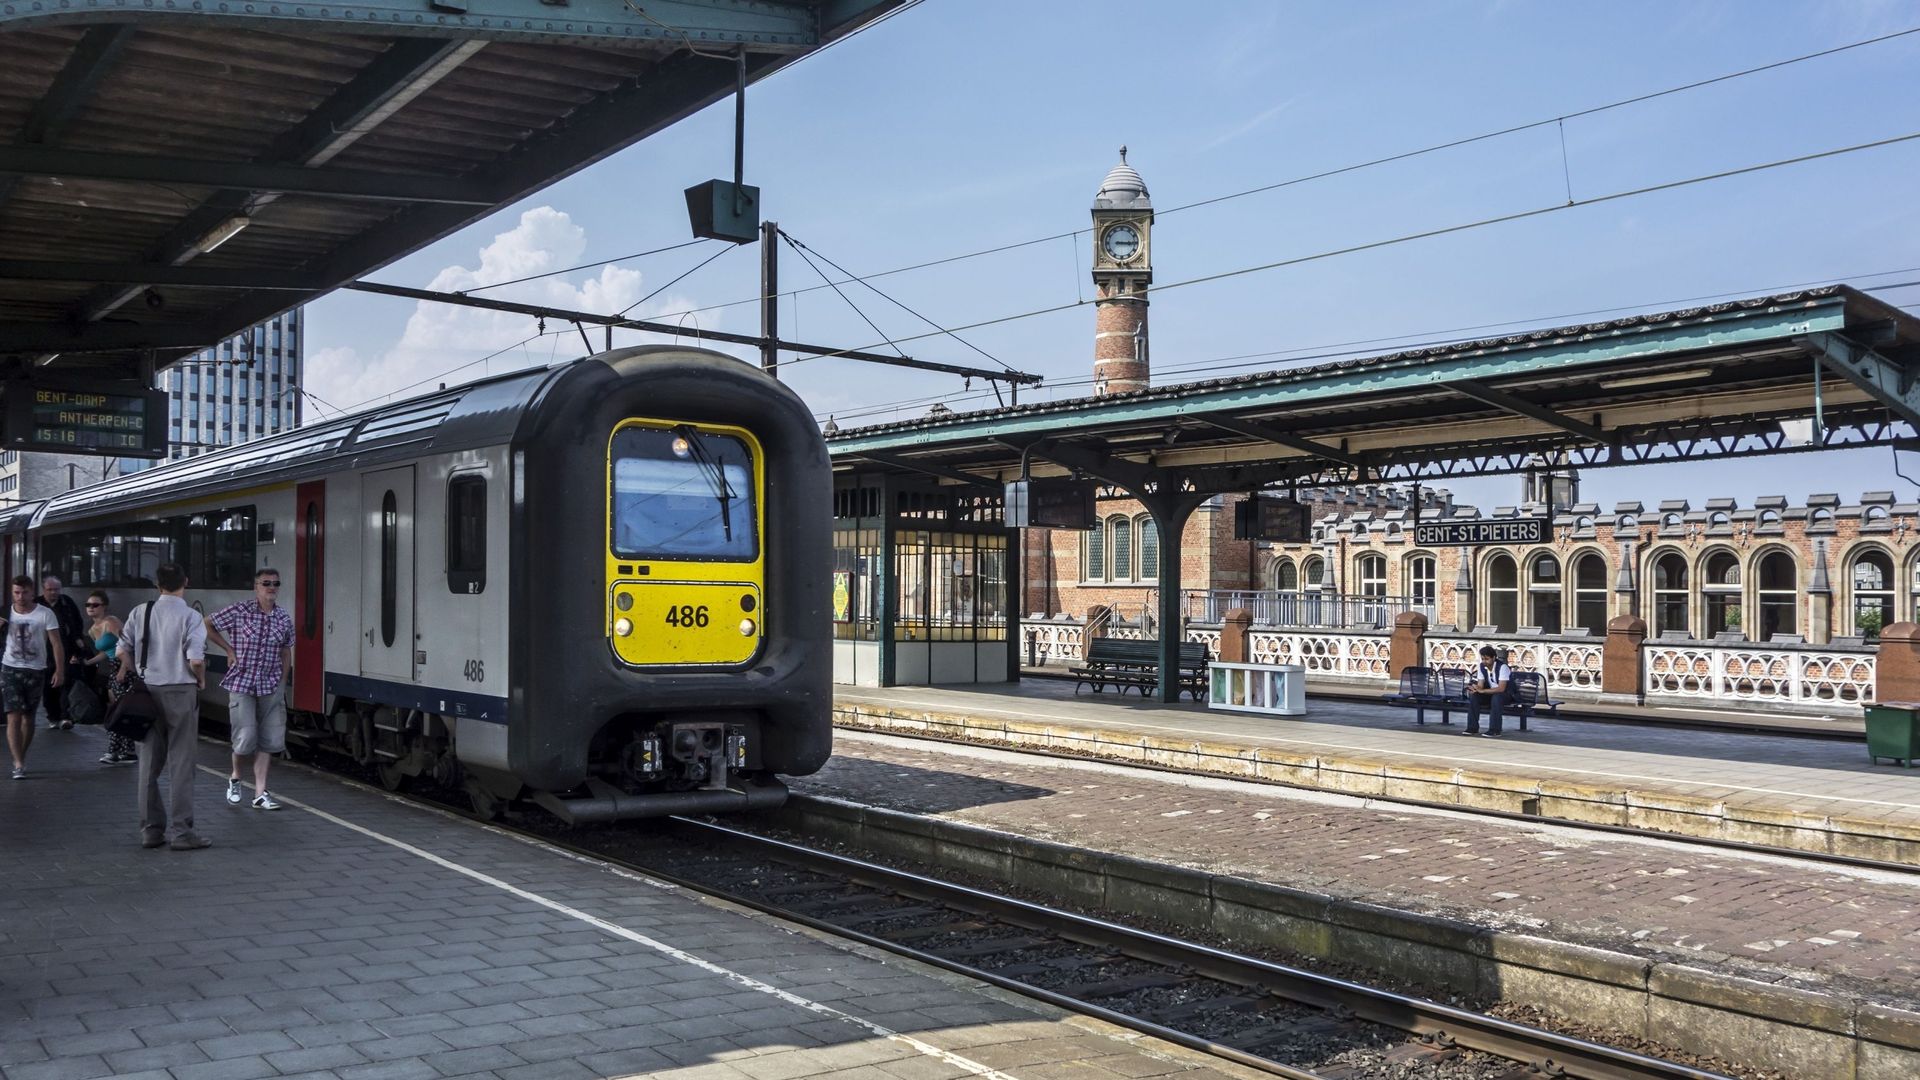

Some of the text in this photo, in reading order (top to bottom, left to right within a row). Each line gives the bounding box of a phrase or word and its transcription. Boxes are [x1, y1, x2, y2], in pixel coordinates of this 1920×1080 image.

[37, 429, 136, 446] 15:16 IC
[1480, 523, 1538, 541] PIETERS
[665, 605, 709, 628] 486
[464, 659, 485, 683] 486
